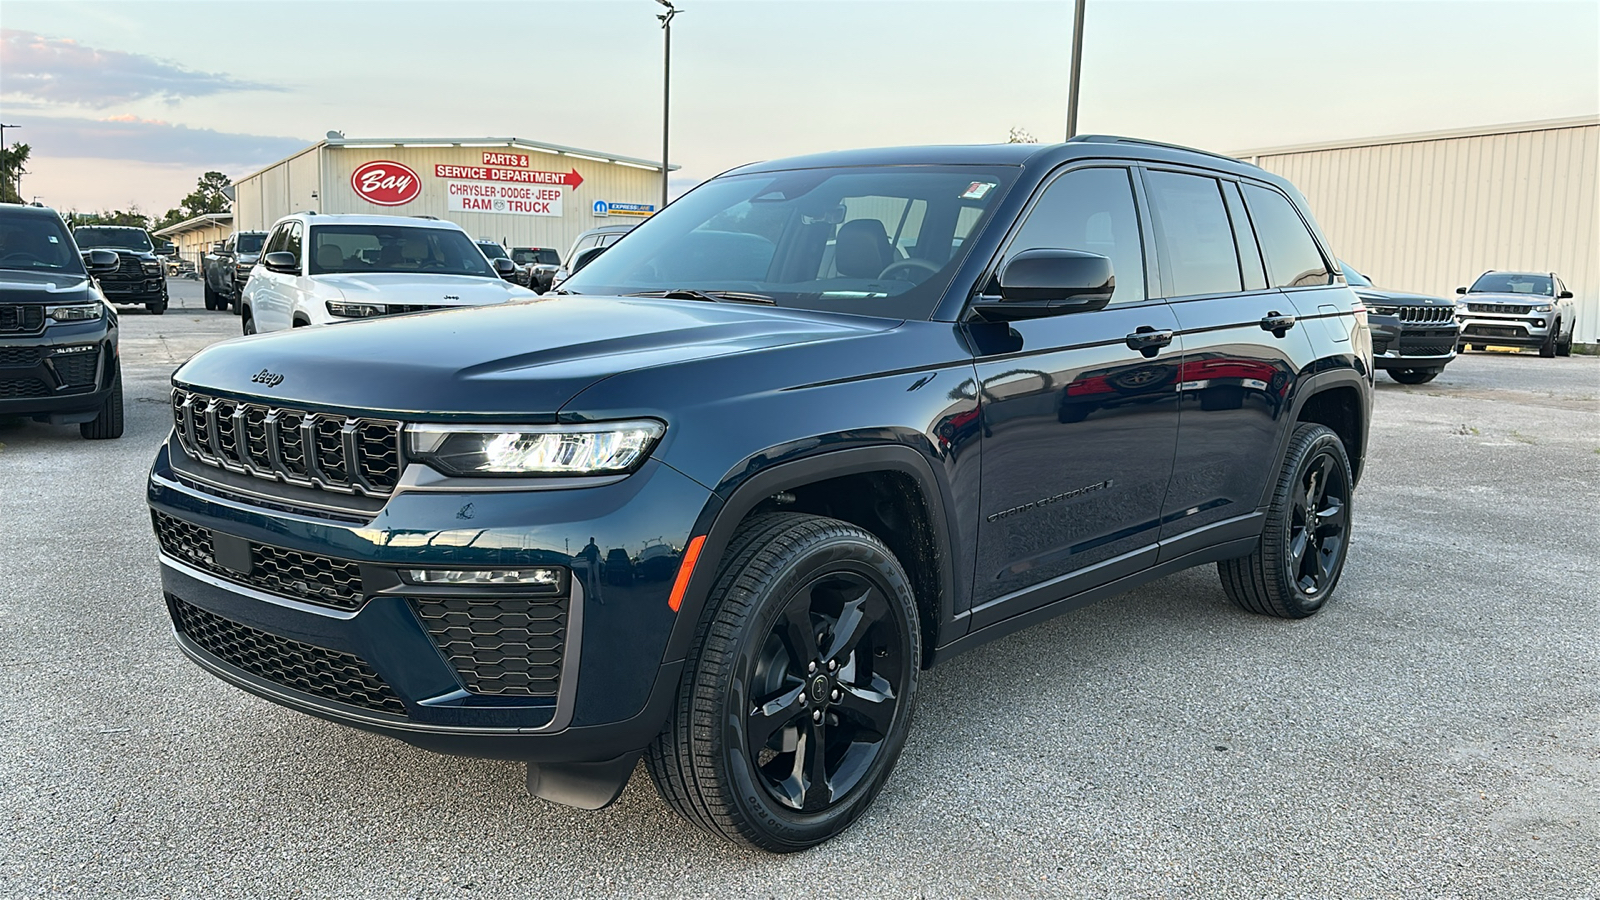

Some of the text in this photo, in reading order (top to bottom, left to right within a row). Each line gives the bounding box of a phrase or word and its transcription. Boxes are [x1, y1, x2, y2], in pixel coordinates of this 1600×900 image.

[483, 153, 528, 166] PARTS &
[360, 169, 413, 194] Bay
[437, 165, 566, 184] SERVICE DEPARTMENT
[462, 197, 550, 213] RAM TRUCK
[251, 368, 285, 388] Jeep
[897, 583, 919, 683] SCORPION
